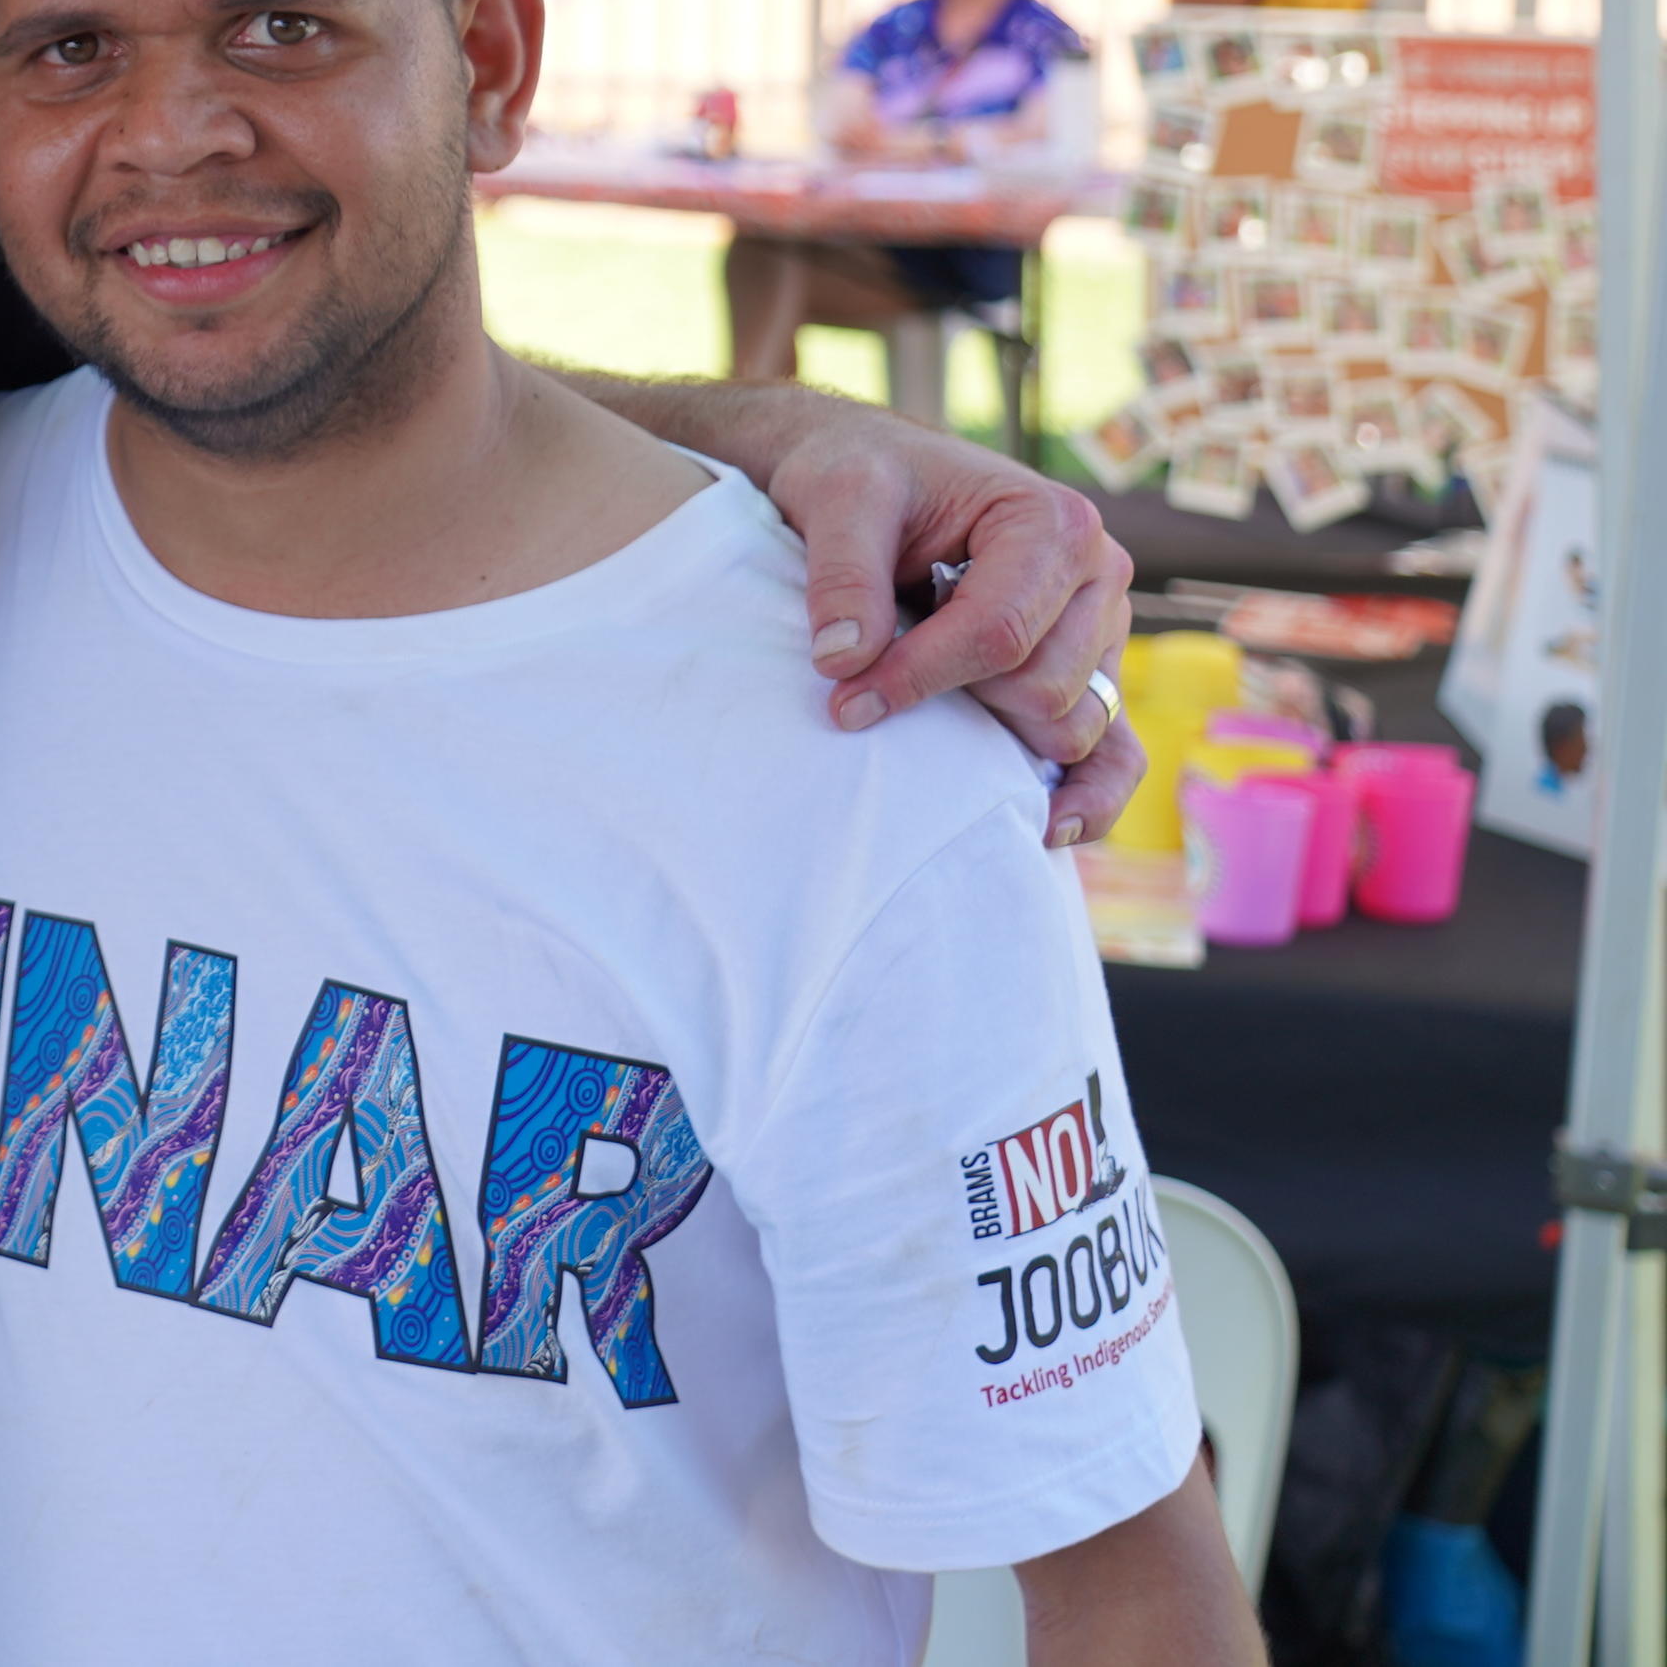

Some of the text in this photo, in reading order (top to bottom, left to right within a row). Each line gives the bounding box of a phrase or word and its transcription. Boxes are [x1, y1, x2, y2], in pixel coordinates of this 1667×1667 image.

[961, 1150, 1003, 1241] BRAMS
[980, 1317, 1152, 1409] Tackling Indigenous
